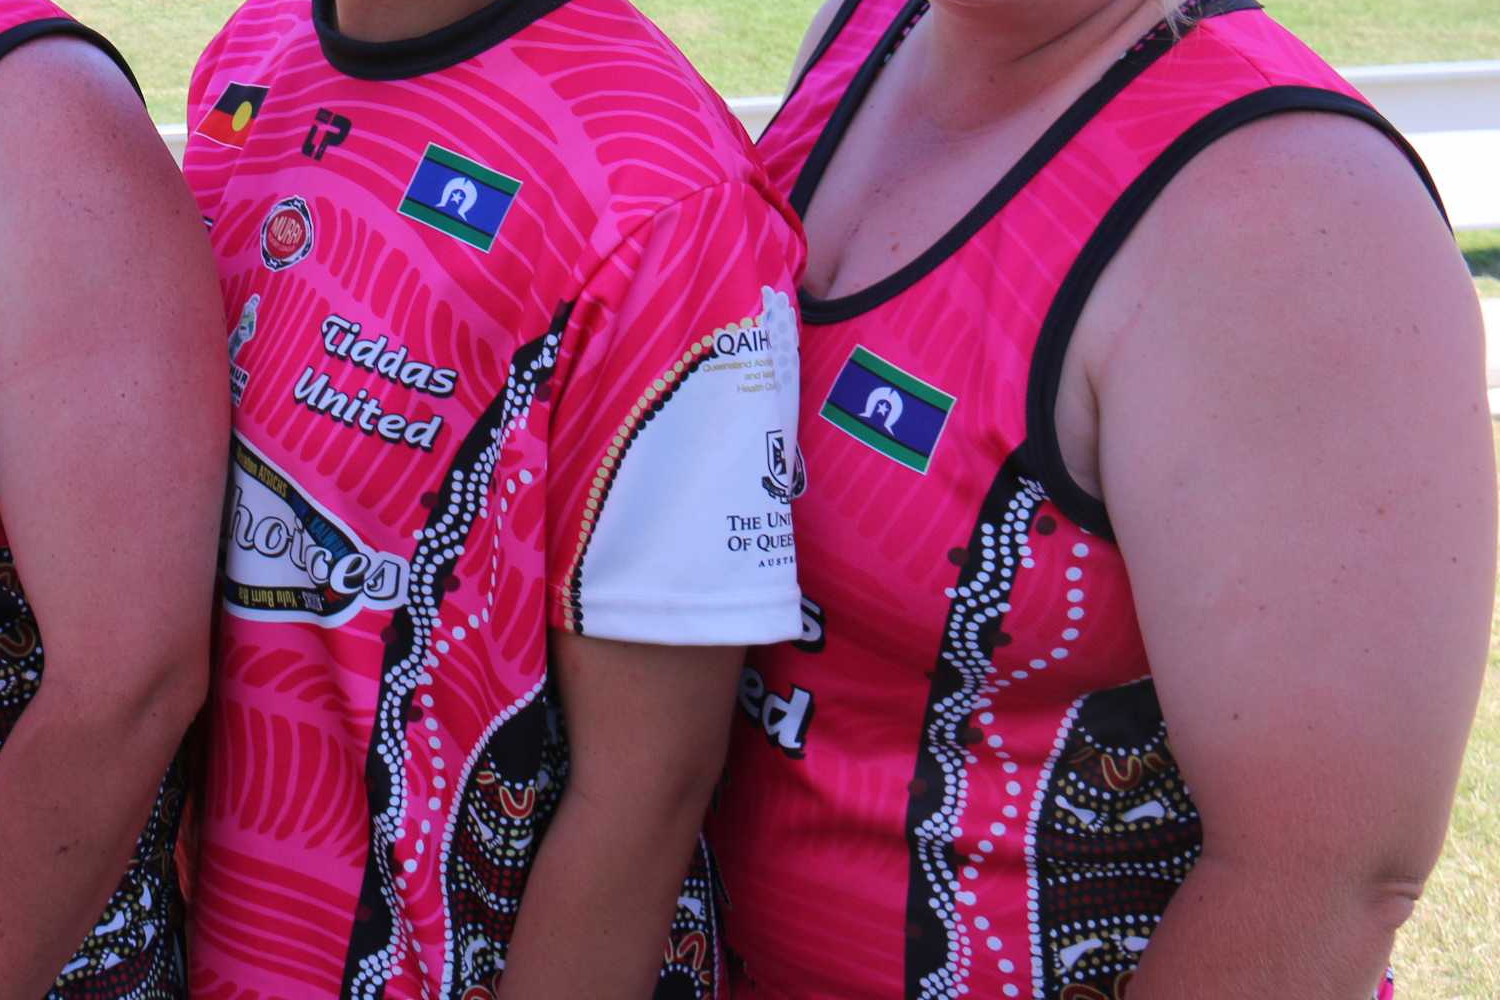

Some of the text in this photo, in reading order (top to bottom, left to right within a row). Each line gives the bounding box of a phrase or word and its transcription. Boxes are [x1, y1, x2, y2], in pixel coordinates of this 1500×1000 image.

[271, 216, 303, 244] MURRI
[321, 313, 458, 398] Tiddas
[293, 366, 444, 452] United
